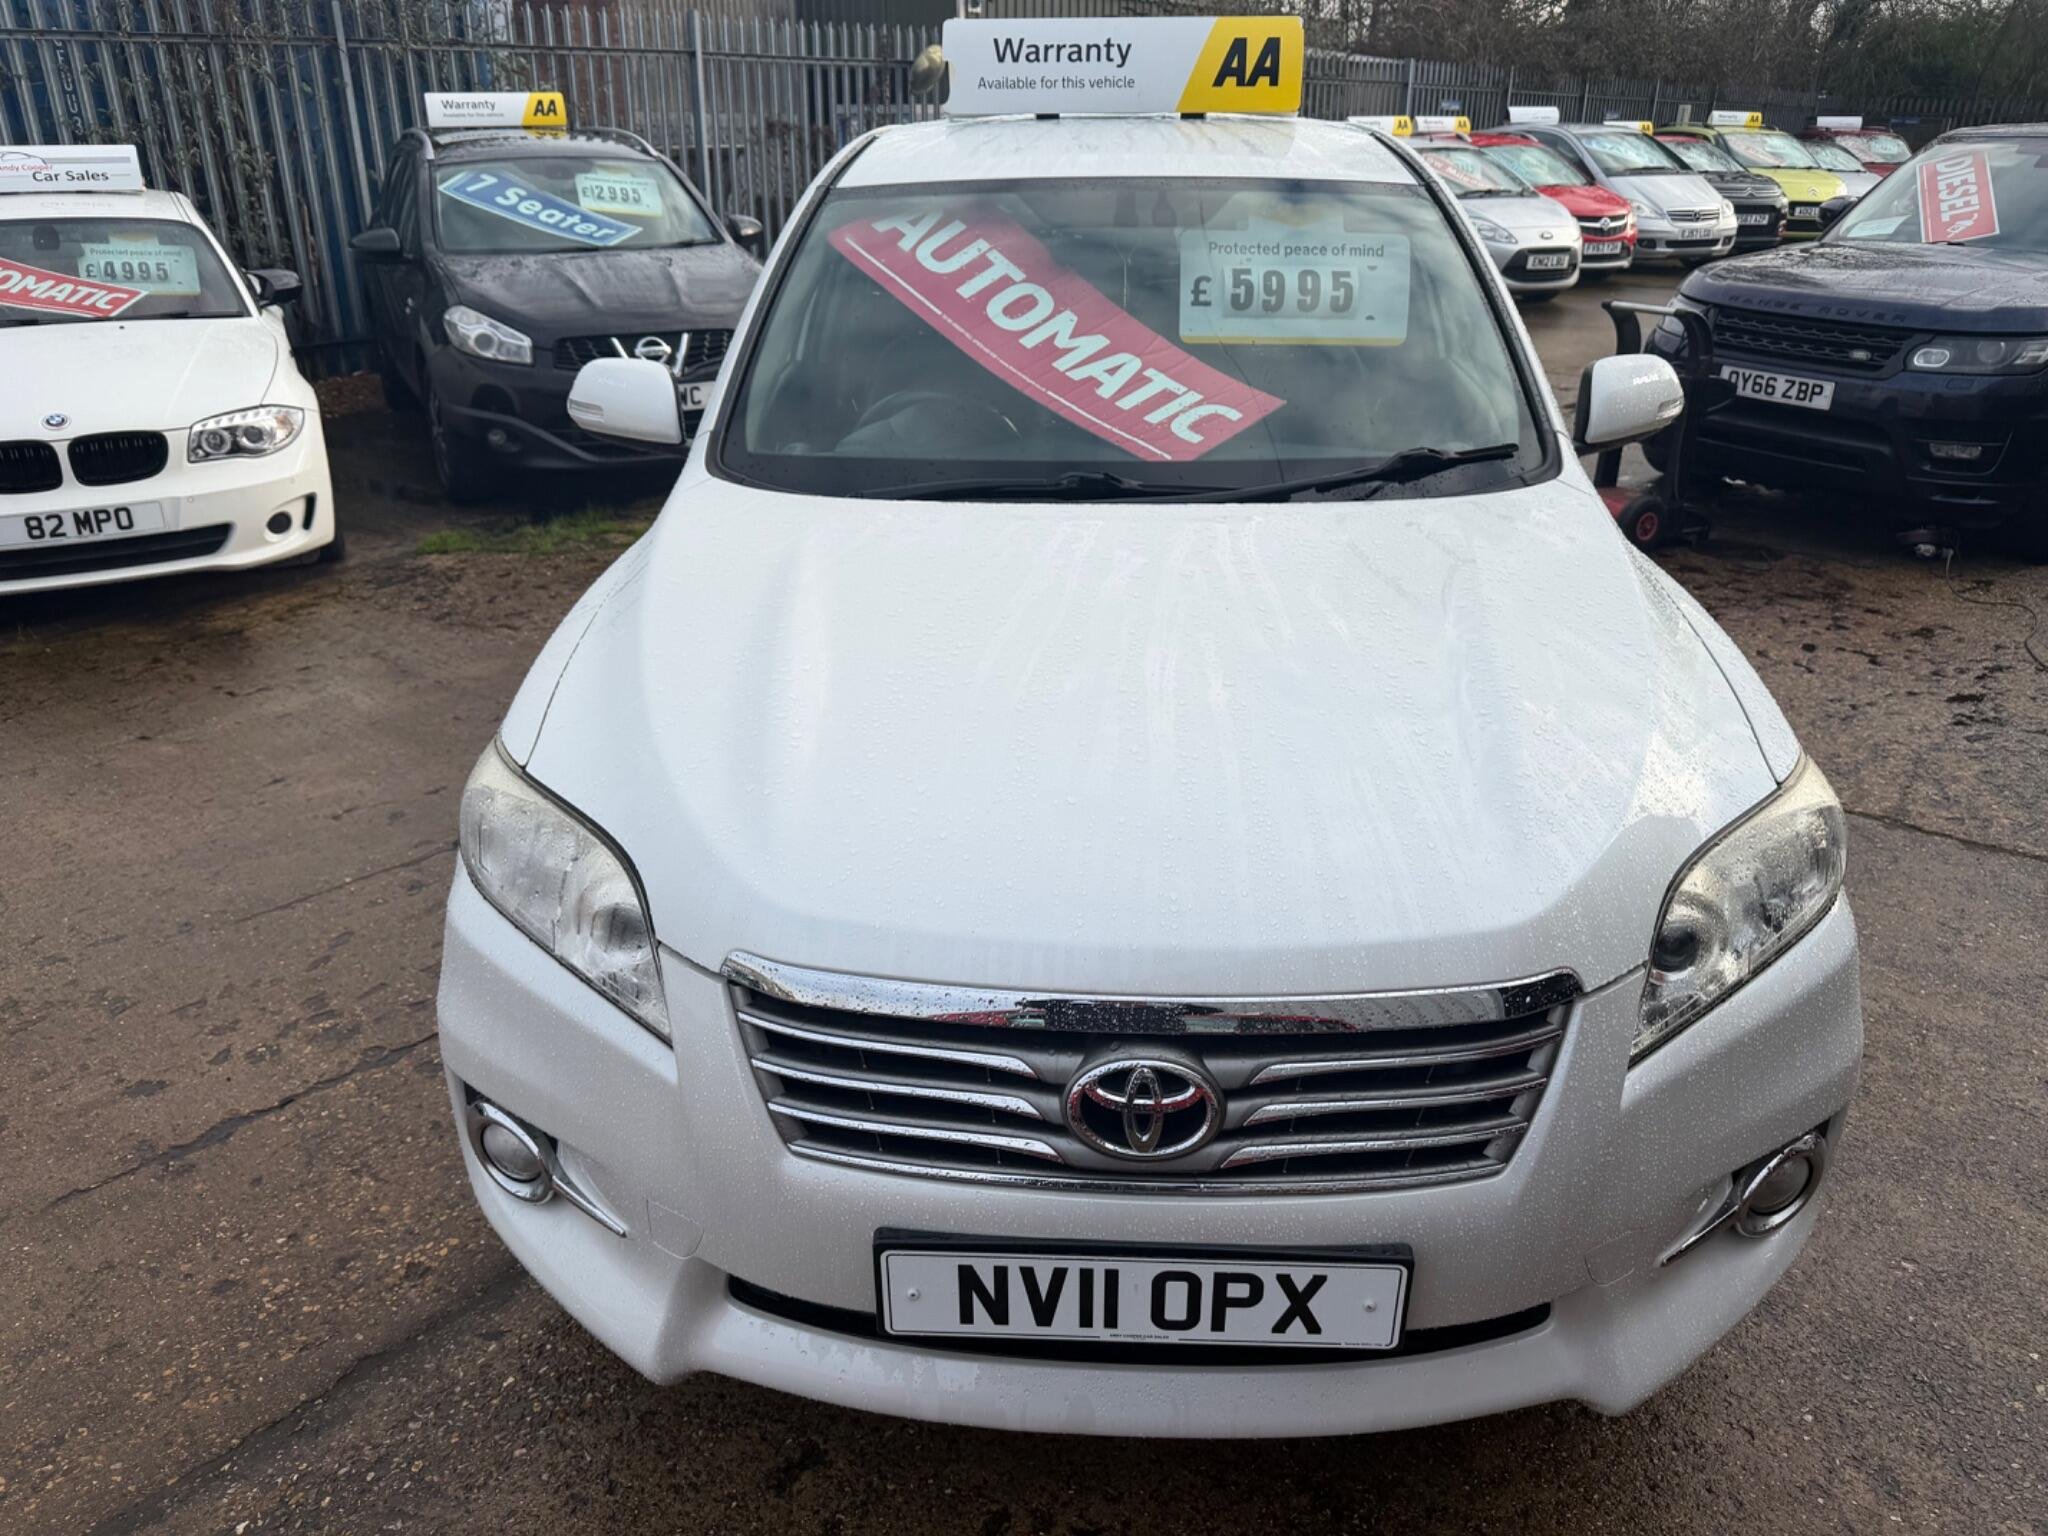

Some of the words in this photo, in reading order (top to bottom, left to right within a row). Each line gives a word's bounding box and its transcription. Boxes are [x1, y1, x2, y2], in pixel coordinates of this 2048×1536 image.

[993, 37, 1132, 68] Warranty
[1212, 37, 1281, 87] AA
[977, 76, 1037, 90] Available
[1041, 77, 1059, 89] for
[1062, 75, 1085, 89] this
[1089, 75, 1135, 89] vehicle
[441, 100, 496, 111] Warranty
[534, 99, 557, 116] AA
[32, 171, 60, 182] Car
[65, 170, 110, 182] Sales
[1936, 153, 1980, 222] DIESEL
[466, 173, 499, 193] 7
[495, 187, 617, 238] Seater
[1209, 242, 1280, 256] Protected
[1284, 245, 1328, 258] peace
[1331, 244, 1347, 256] of
[1349, 245, 1385, 257] mind
[0, 267, 129, 309] OMATIC
[870, 206, 1243, 444] AUTOMATIC
[1781, 379, 1823, 403] ZBP
[24, 514, 67, 540] 82
[72, 506, 134, 536] MPO
[1150, 1269, 1328, 1335] OPX
